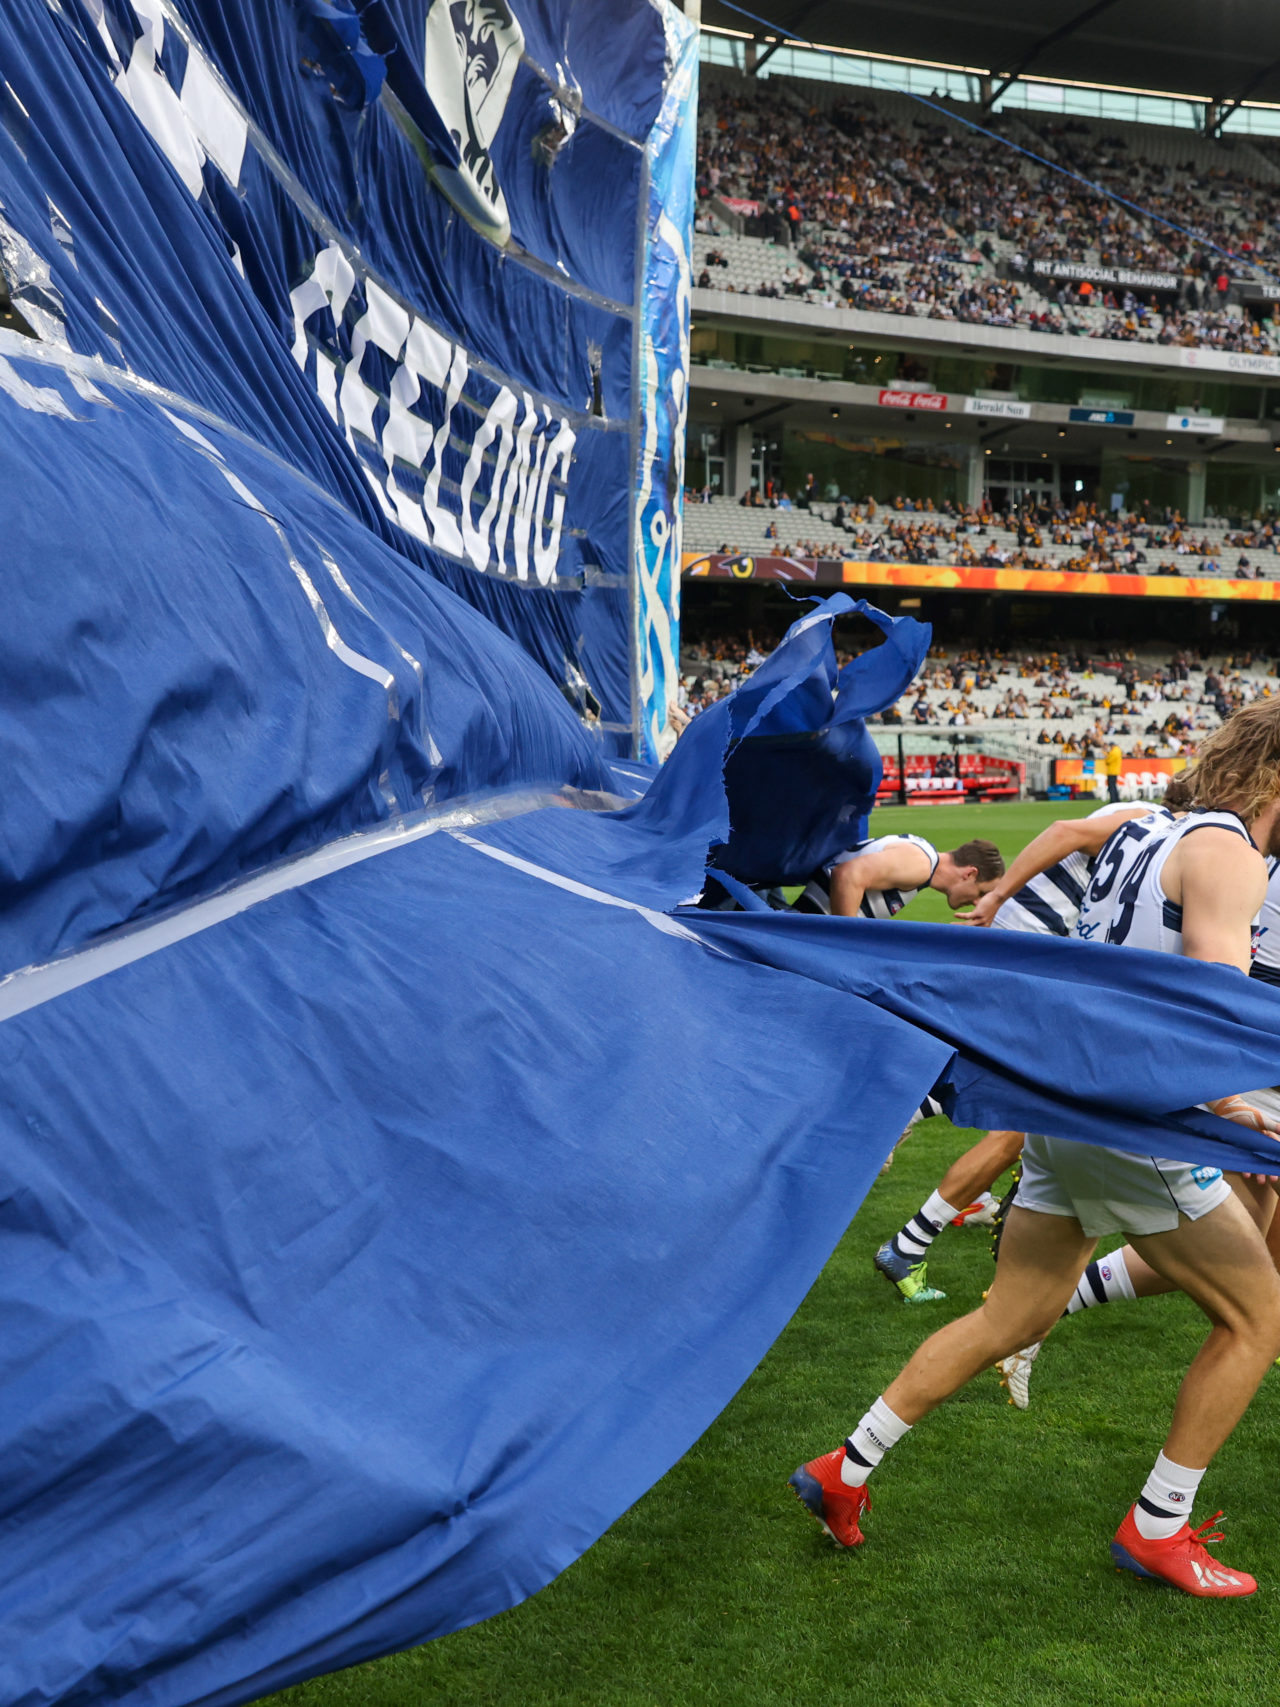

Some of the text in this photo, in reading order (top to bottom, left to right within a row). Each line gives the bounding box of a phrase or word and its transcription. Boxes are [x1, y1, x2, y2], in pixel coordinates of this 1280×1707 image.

[1054, 264, 1116, 283] ANTISOCIAL
[1118, 271, 1177, 289] BEHAVIOUR
[1228, 356, 1275, 372] OLYMPIC
[972, 400, 1025, 415] Herald Sun
